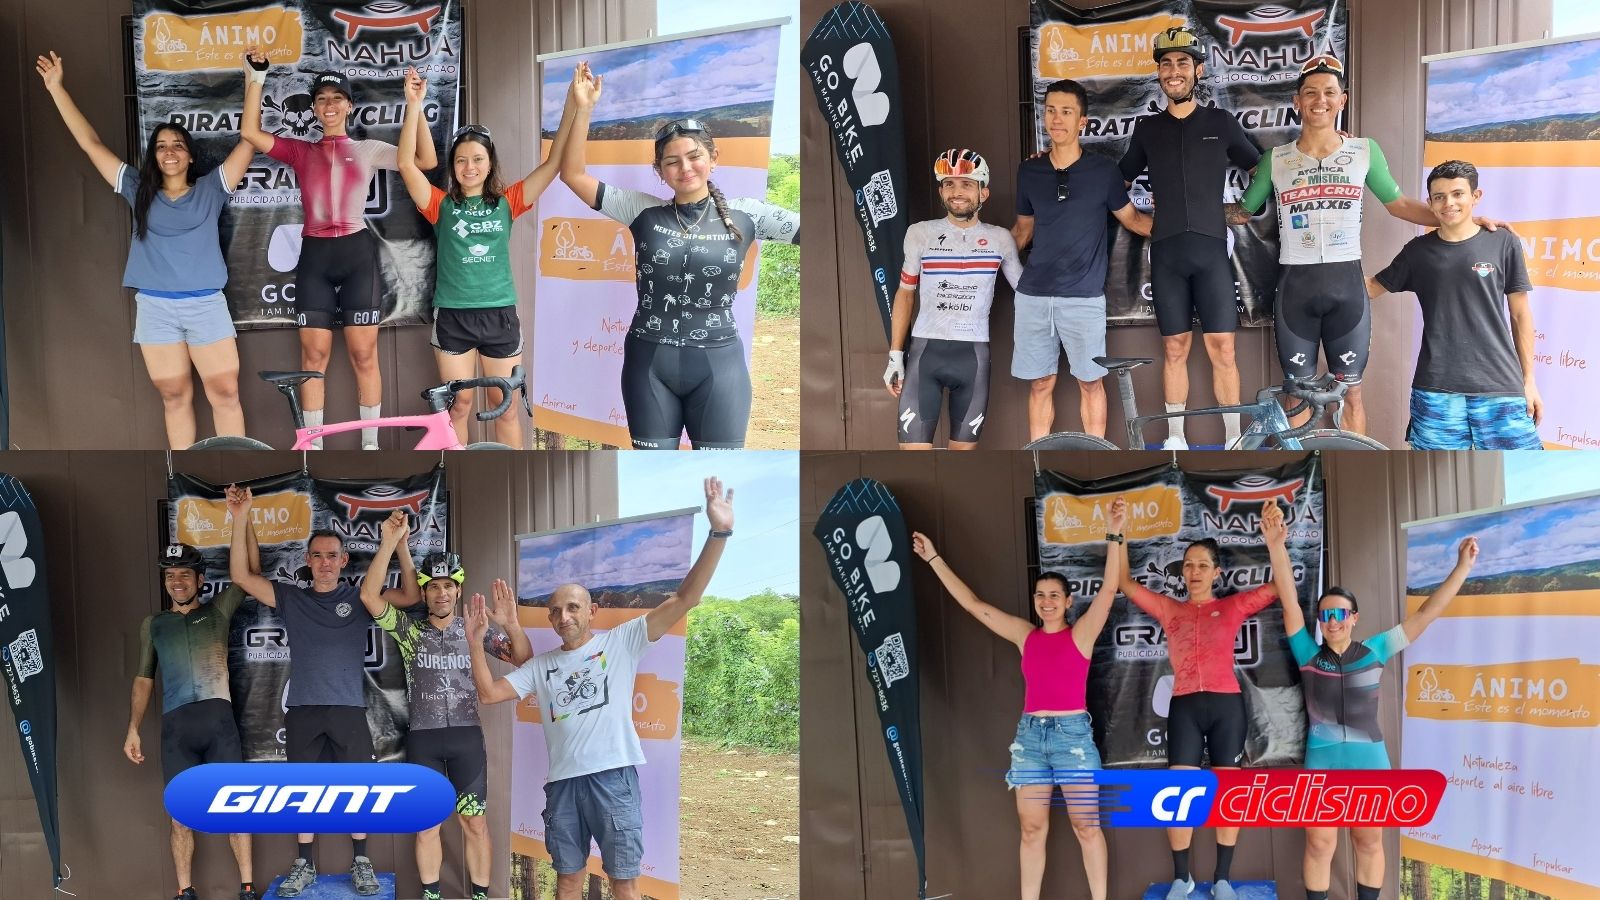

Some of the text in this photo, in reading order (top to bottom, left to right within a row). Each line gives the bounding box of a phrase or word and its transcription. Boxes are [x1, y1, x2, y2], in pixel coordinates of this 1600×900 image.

[200, 21, 277, 46] ÁNIMO
[327, 34, 454, 64] NAHUA
[819, 54, 865, 164] GO BIKE
[820, 87, 841, 129] MAKING
[1282, 188, 1321, 203] TEAM
[1323, 186, 1361, 197] CRUZ
[1289, 199, 1352, 214] MAXXIS
[470, 220, 503, 230] CBZ
[653, 224, 682, 238] MENTES
[462, 255, 496, 264] SECNET
[948, 303, 972, 311] kölbi
[1559, 350, 1586, 369] libre
[435, 565, 446, 574] 21
[833, 527, 876, 628] GO BIKE
[834, 558, 853, 596] MAKING
[248, 652, 290, 660] PUBLICIDA
[417, 652, 472, 670] SUREÑOS
[1118, 650, 1165, 658] PUBLICIDAD
[1317, 657, 1336, 671] Hope
[1470, 673, 1568, 700] ÁNIMO
[1463, 700, 1590, 719] Este es el momento
[1462, 754, 1518, 772] Naturaleza
[1493, 778, 1503, 792] al
[1507, 782, 1526, 795] aire
[1531, 781, 1554, 800] libre
[1408, 827, 1442, 841] Animar
[1471, 838, 1503, 857] Apoyar
[1532, 852, 1573, 874] Impulsar
